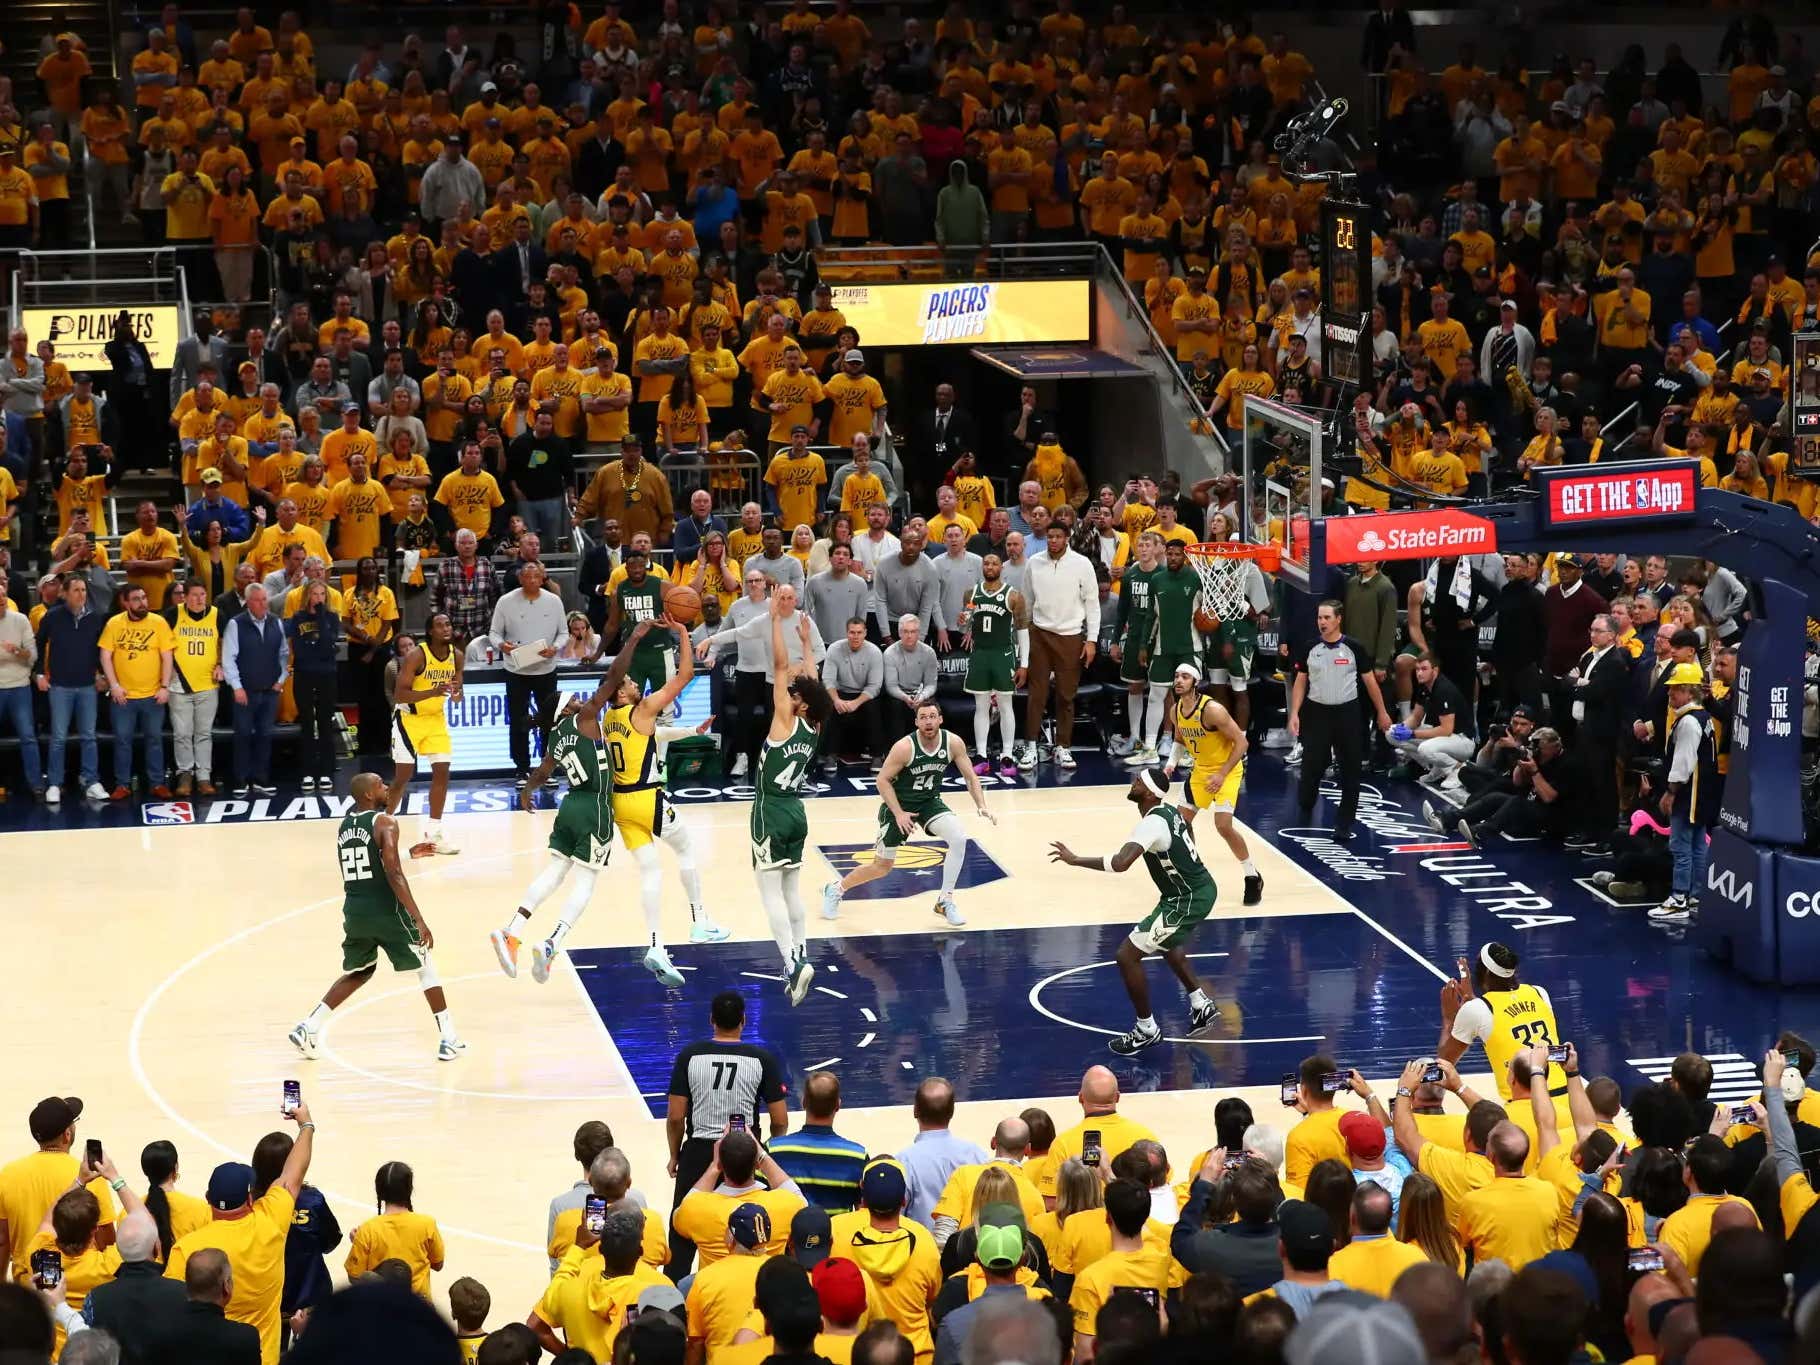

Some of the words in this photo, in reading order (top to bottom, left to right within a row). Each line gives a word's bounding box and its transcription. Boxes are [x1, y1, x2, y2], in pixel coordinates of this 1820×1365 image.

[1336, 218, 1354, 250] 22
[927, 284, 990, 320] PACERS
[78, 313, 154, 340] PLAYFS
[923, 314, 986, 345] PLAYOFFS
[777, 384, 808, 397] INDY
[1655, 377, 1682, 393] INDY
[839, 387, 868, 400] INDY
[785, 467, 818, 482] INDY
[1417, 459, 1450, 474] INDY
[454, 484, 488, 500] INDY
[854, 489, 880, 503] INDY
[1562, 484, 1594, 514] GET
[1598, 480, 1632, 511] THE
[1652, 478, 1683, 512] App
[345, 493, 377, 508] INDY
[356, 507, 375, 515] BACK
[1387, 529, 1438, 551] State
[1438, 525, 1486, 546] Farm
[737, 541, 764, 556] INDY
[1131, 582, 1149, 596] FEAR
[624, 597, 643, 610] FEAR
[633, 609, 655, 623] DEER
[179, 626, 214, 637] INDIANA
[982, 616, 992, 633] 0
[117, 628, 155, 643] INDY
[128, 643, 149, 651] BACK
[187, 641, 205, 656] 00
[1739, 665, 1751, 692] GET
[1770, 687, 1789, 703] GET
[1738, 690, 1750, 719] THE
[1770, 703, 1788, 719] THE
[1178, 729, 1206, 739] NDIANA
[1737, 718, 1750, 751] App
[1774, 721, 1792, 737] App
[553, 734, 578, 761] BEVERLEY
[1190, 739, 1200, 754] 2
[610, 741, 626, 773] 0
[559, 750, 588, 787] 21
[910, 763, 947, 775] MILWAUKEE
[912, 774, 935, 791] 24
[205, 788, 511, 823] PLAYFFS
[1720, 807, 1738, 829] Google
[1737, 815, 1749, 833] Pixel
[341, 846, 374, 881] 22
[1419, 854, 1575, 931] ULTRA
[1503, 1001, 1537, 1019] TURNER
[1511, 1020, 1554, 1050] 33
[711, 1061, 738, 1091] 77
